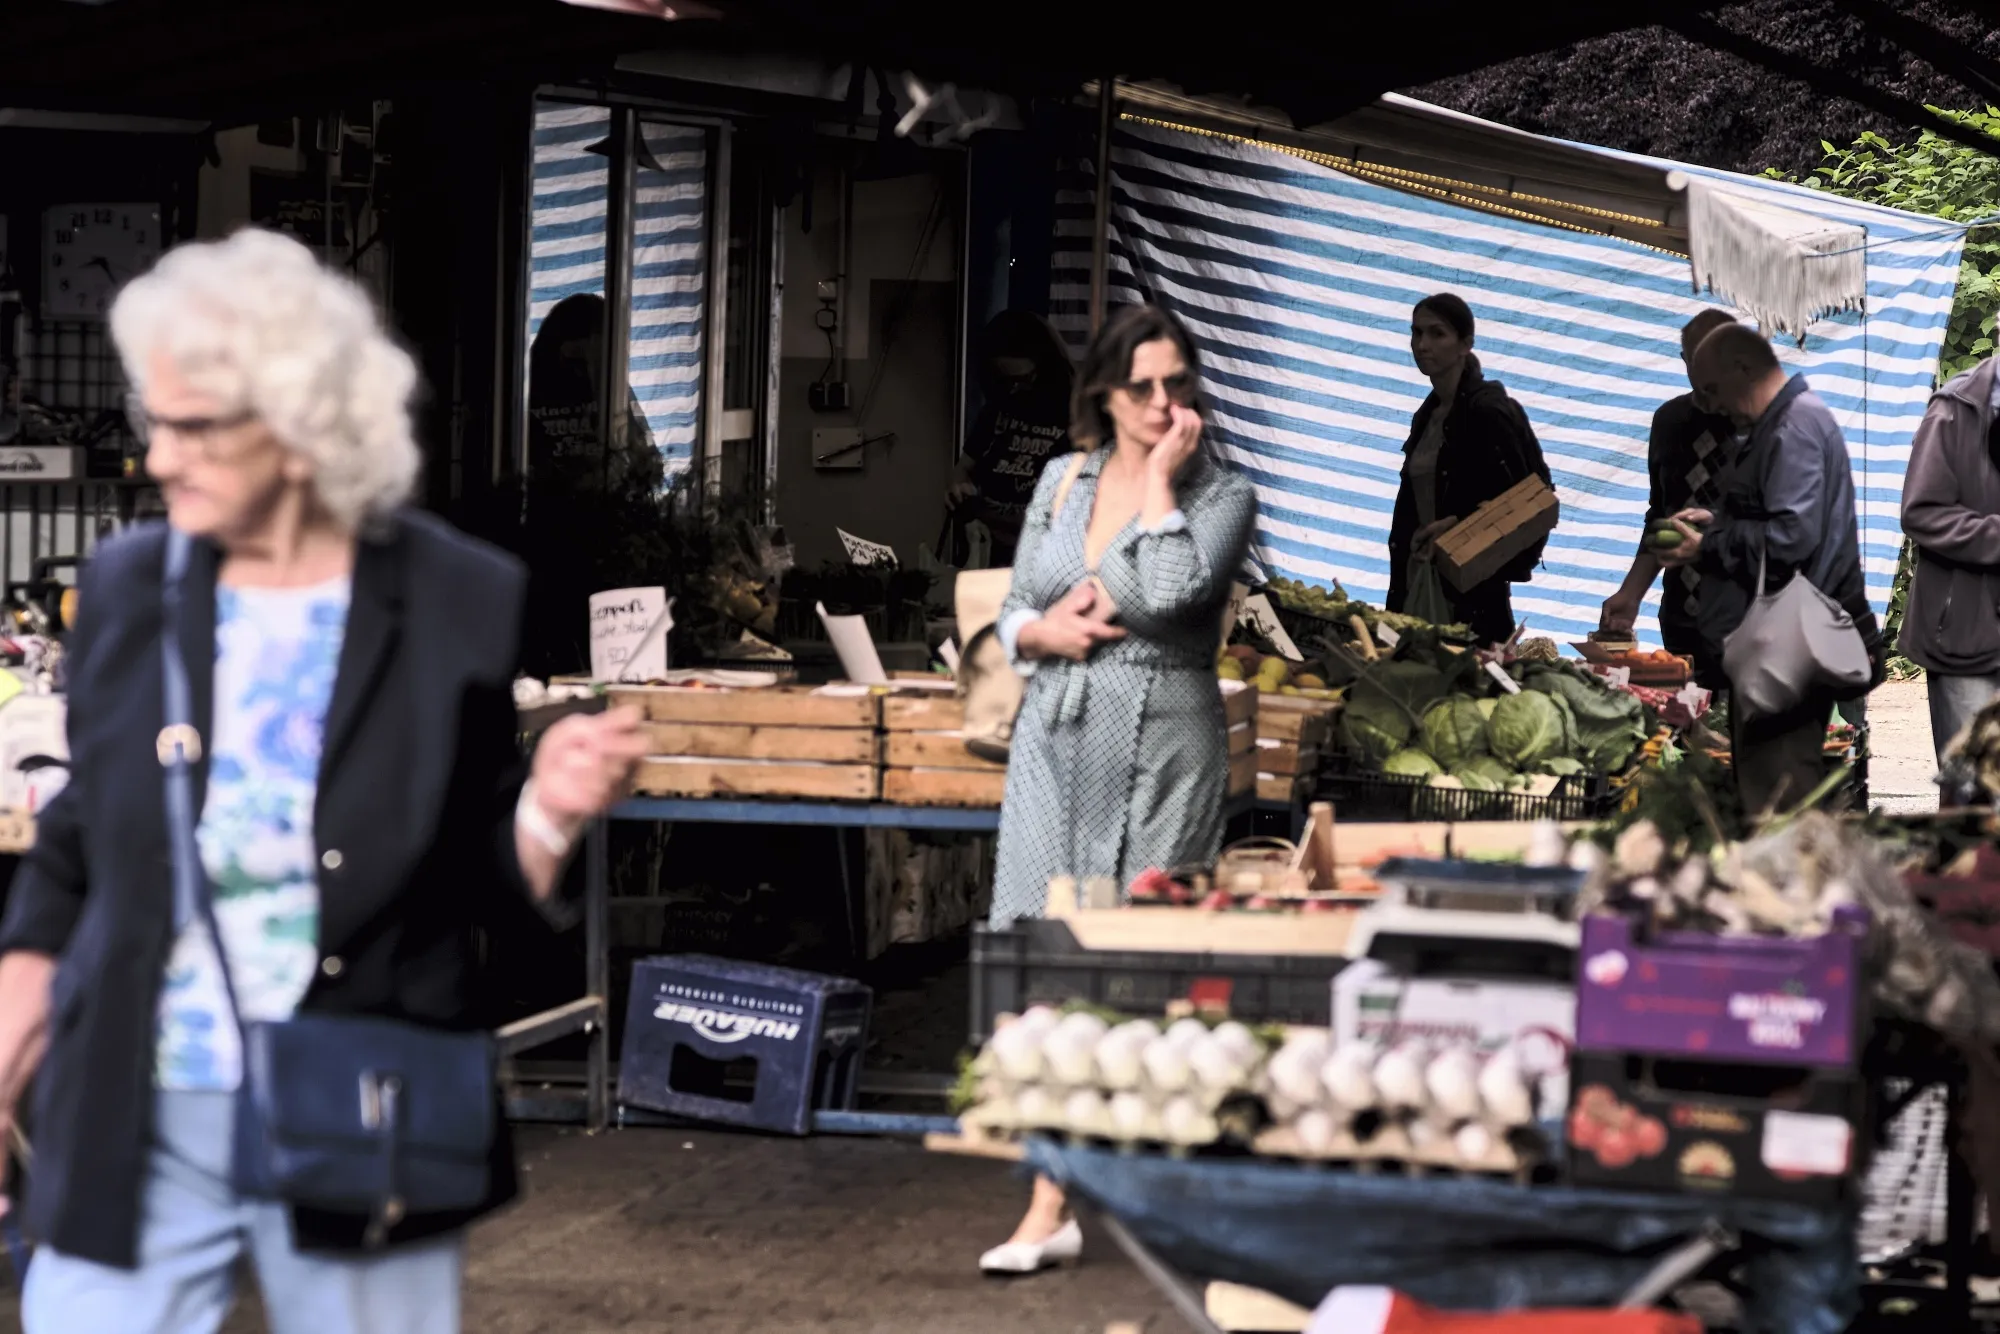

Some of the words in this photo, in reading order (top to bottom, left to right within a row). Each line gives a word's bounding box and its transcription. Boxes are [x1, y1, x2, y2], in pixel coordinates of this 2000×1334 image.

[94, 209, 112, 224] 12
[1031, 425, 1066, 441] only
[652, 1001, 801, 1041] HUBAUER
